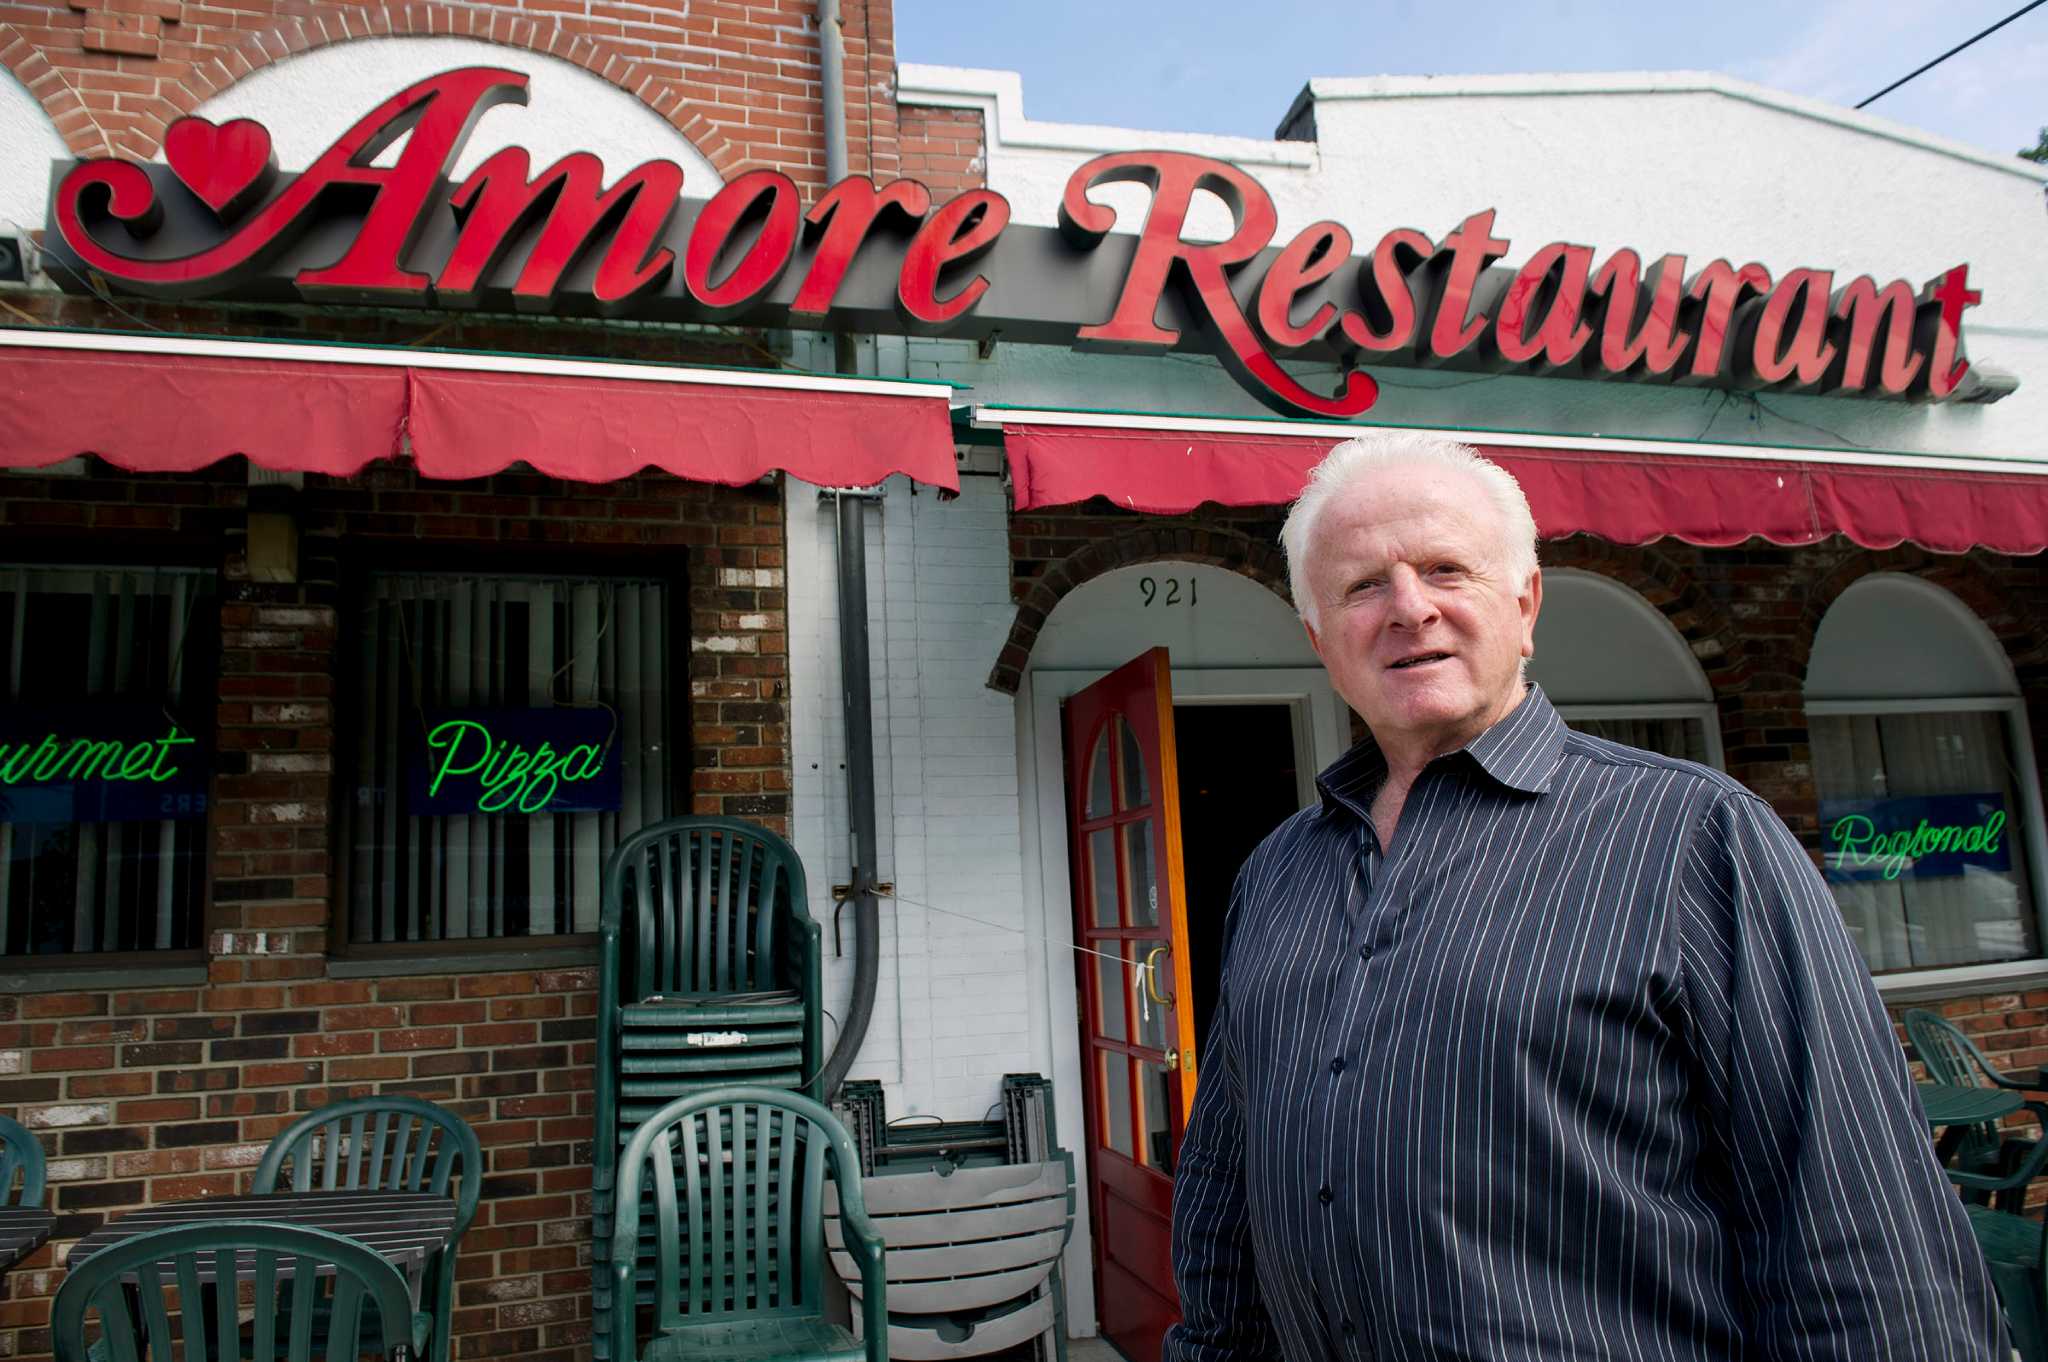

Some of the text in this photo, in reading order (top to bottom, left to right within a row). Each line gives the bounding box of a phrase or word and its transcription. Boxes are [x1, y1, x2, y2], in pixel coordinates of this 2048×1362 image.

[53, 66, 1983, 420] Amore Restaurant
[1139, 576, 1198, 608] 921
[427, 719, 603, 814] Pizza
[1831, 808, 2007, 881] Regional
